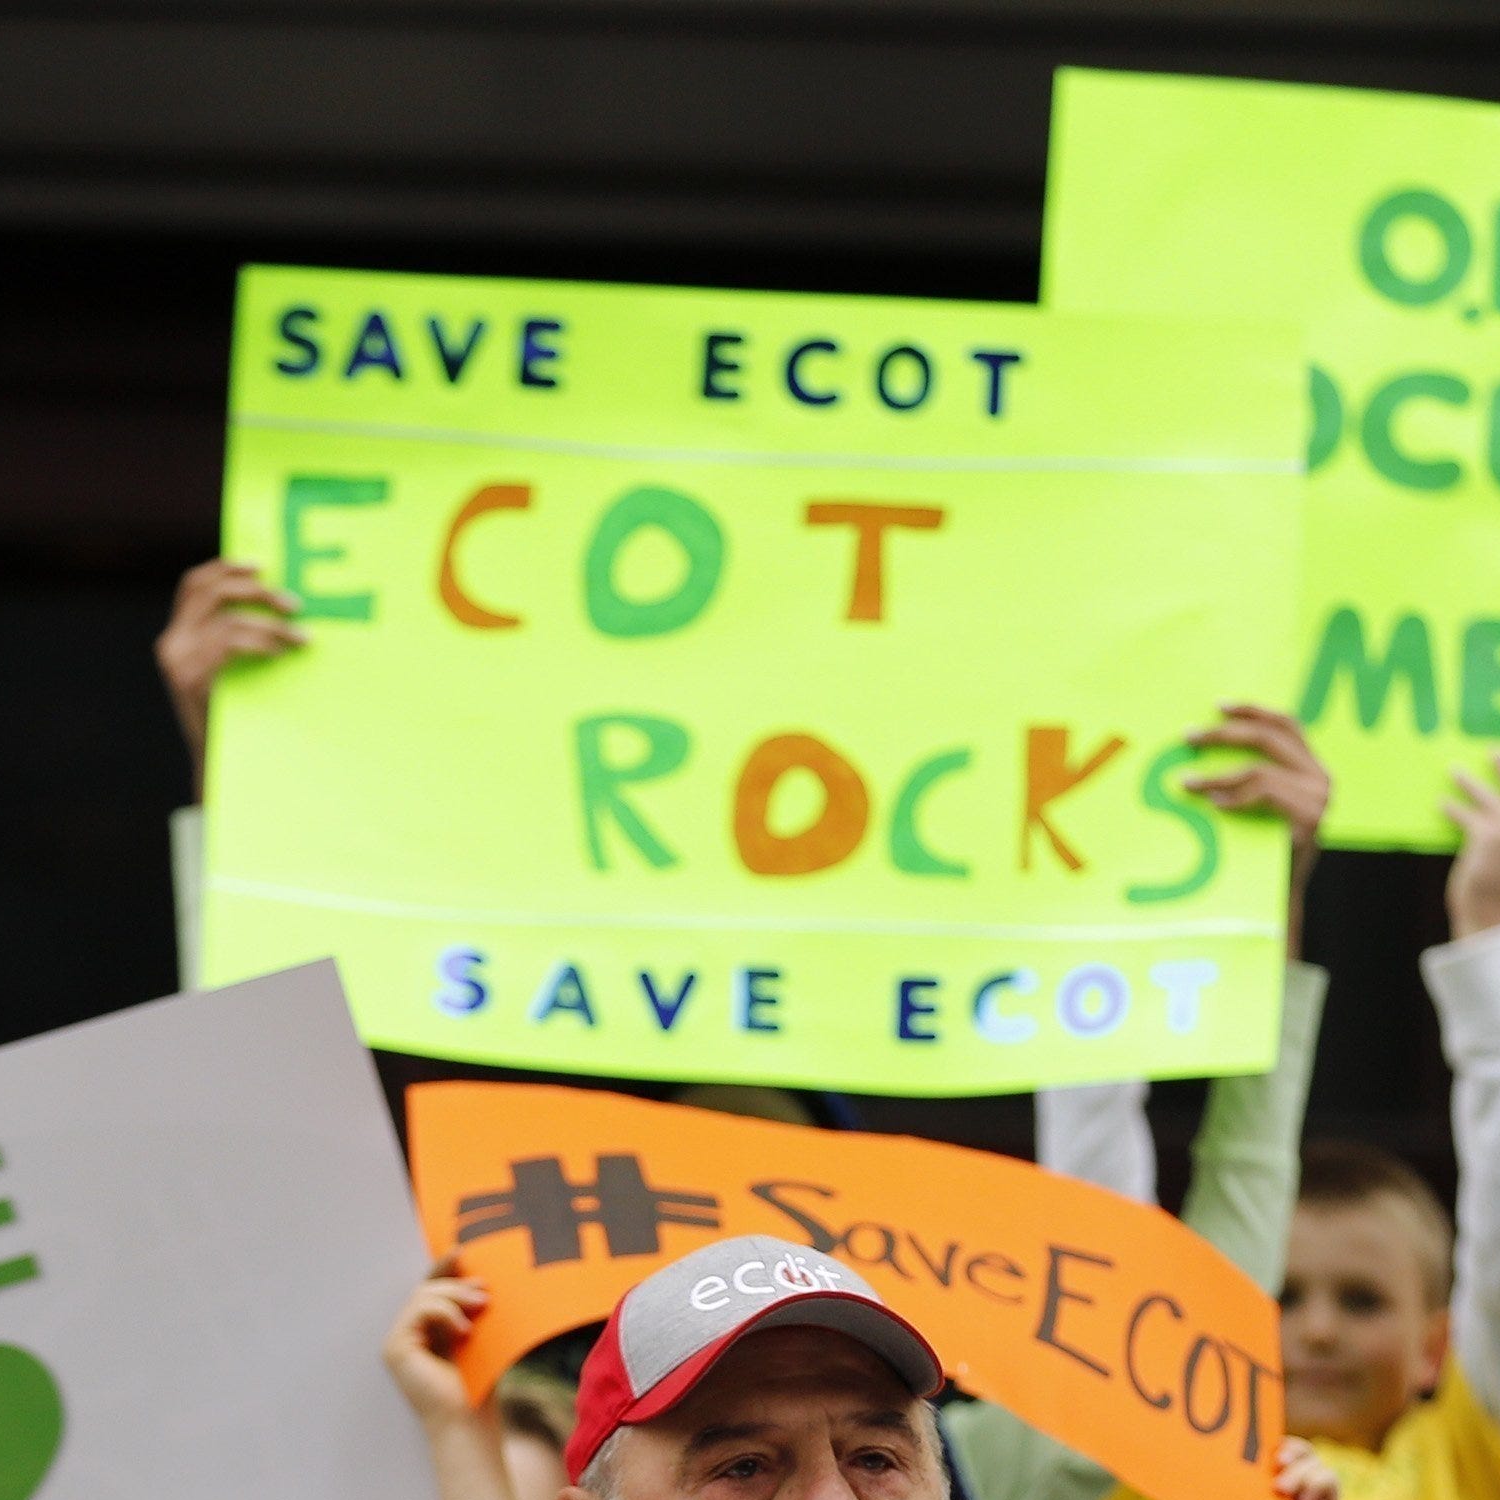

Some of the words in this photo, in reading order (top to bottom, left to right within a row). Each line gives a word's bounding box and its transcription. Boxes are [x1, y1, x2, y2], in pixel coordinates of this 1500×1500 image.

[274, 306, 563, 389] SAVE
[700, 332, 1022, 417] ECOT
[279, 473, 949, 637] ECOT
[572, 712, 1221, 904] ROCKS
[434, 945, 784, 1031] SAVE
[896, 960, 1219, 1042] ECOT
